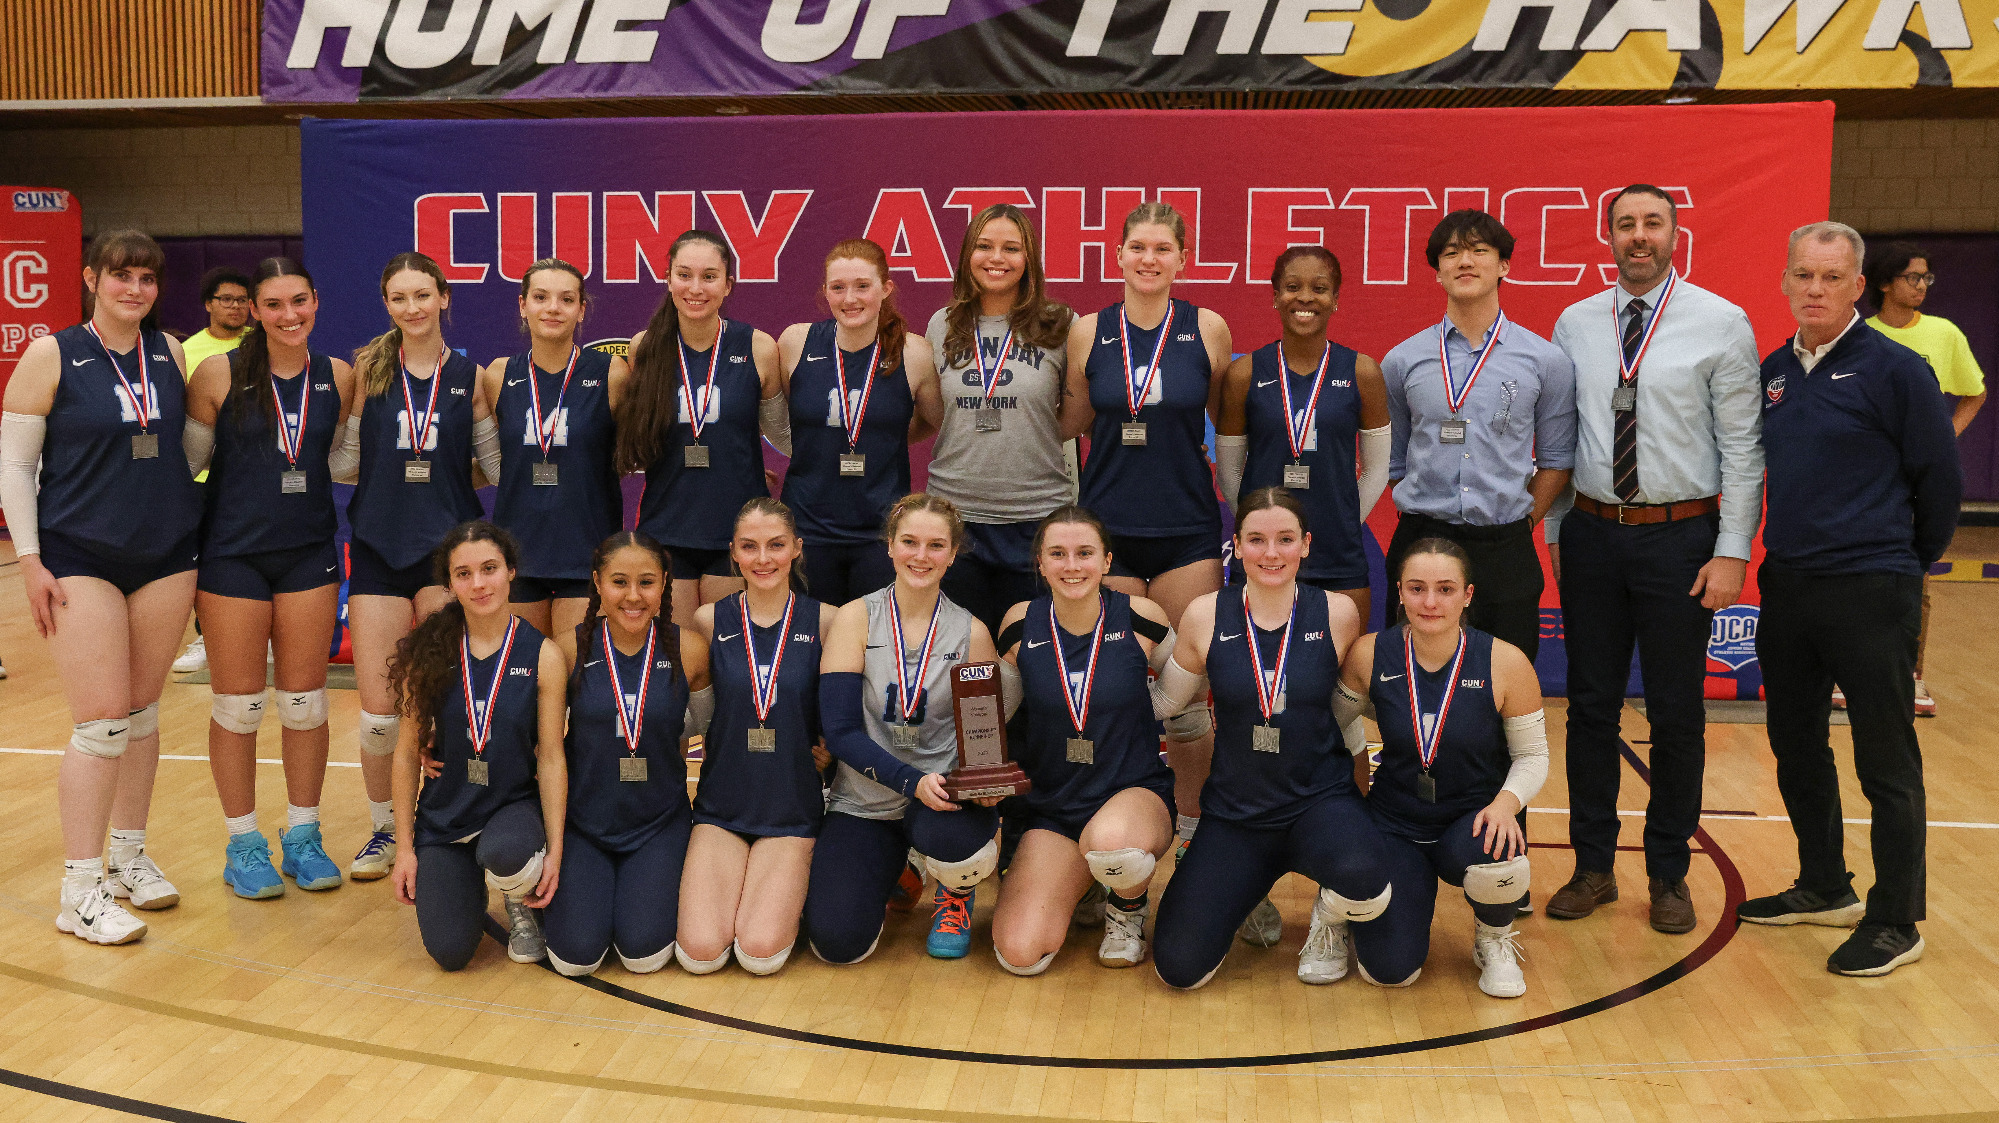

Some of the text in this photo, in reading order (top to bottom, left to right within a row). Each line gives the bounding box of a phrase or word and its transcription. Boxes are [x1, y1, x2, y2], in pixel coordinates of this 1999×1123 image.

[287, 0, 669, 68] HOME
[761, 0, 951, 62] OF
[1473, 0, 1999, 54] HAWK
[14, 191, 69, 210] CUNY
[414, 186, 1694, 286] CUNY ATHLETC
[3, 251, 49, 308] C
[677, 384, 721, 424] 10
[956, 396, 983, 409] NEW
[1135, 365, 1162, 405] 9
[396, 409, 440, 451] 15
[523, 406, 569, 447] 14
[960, 665, 994, 679] CUNY
